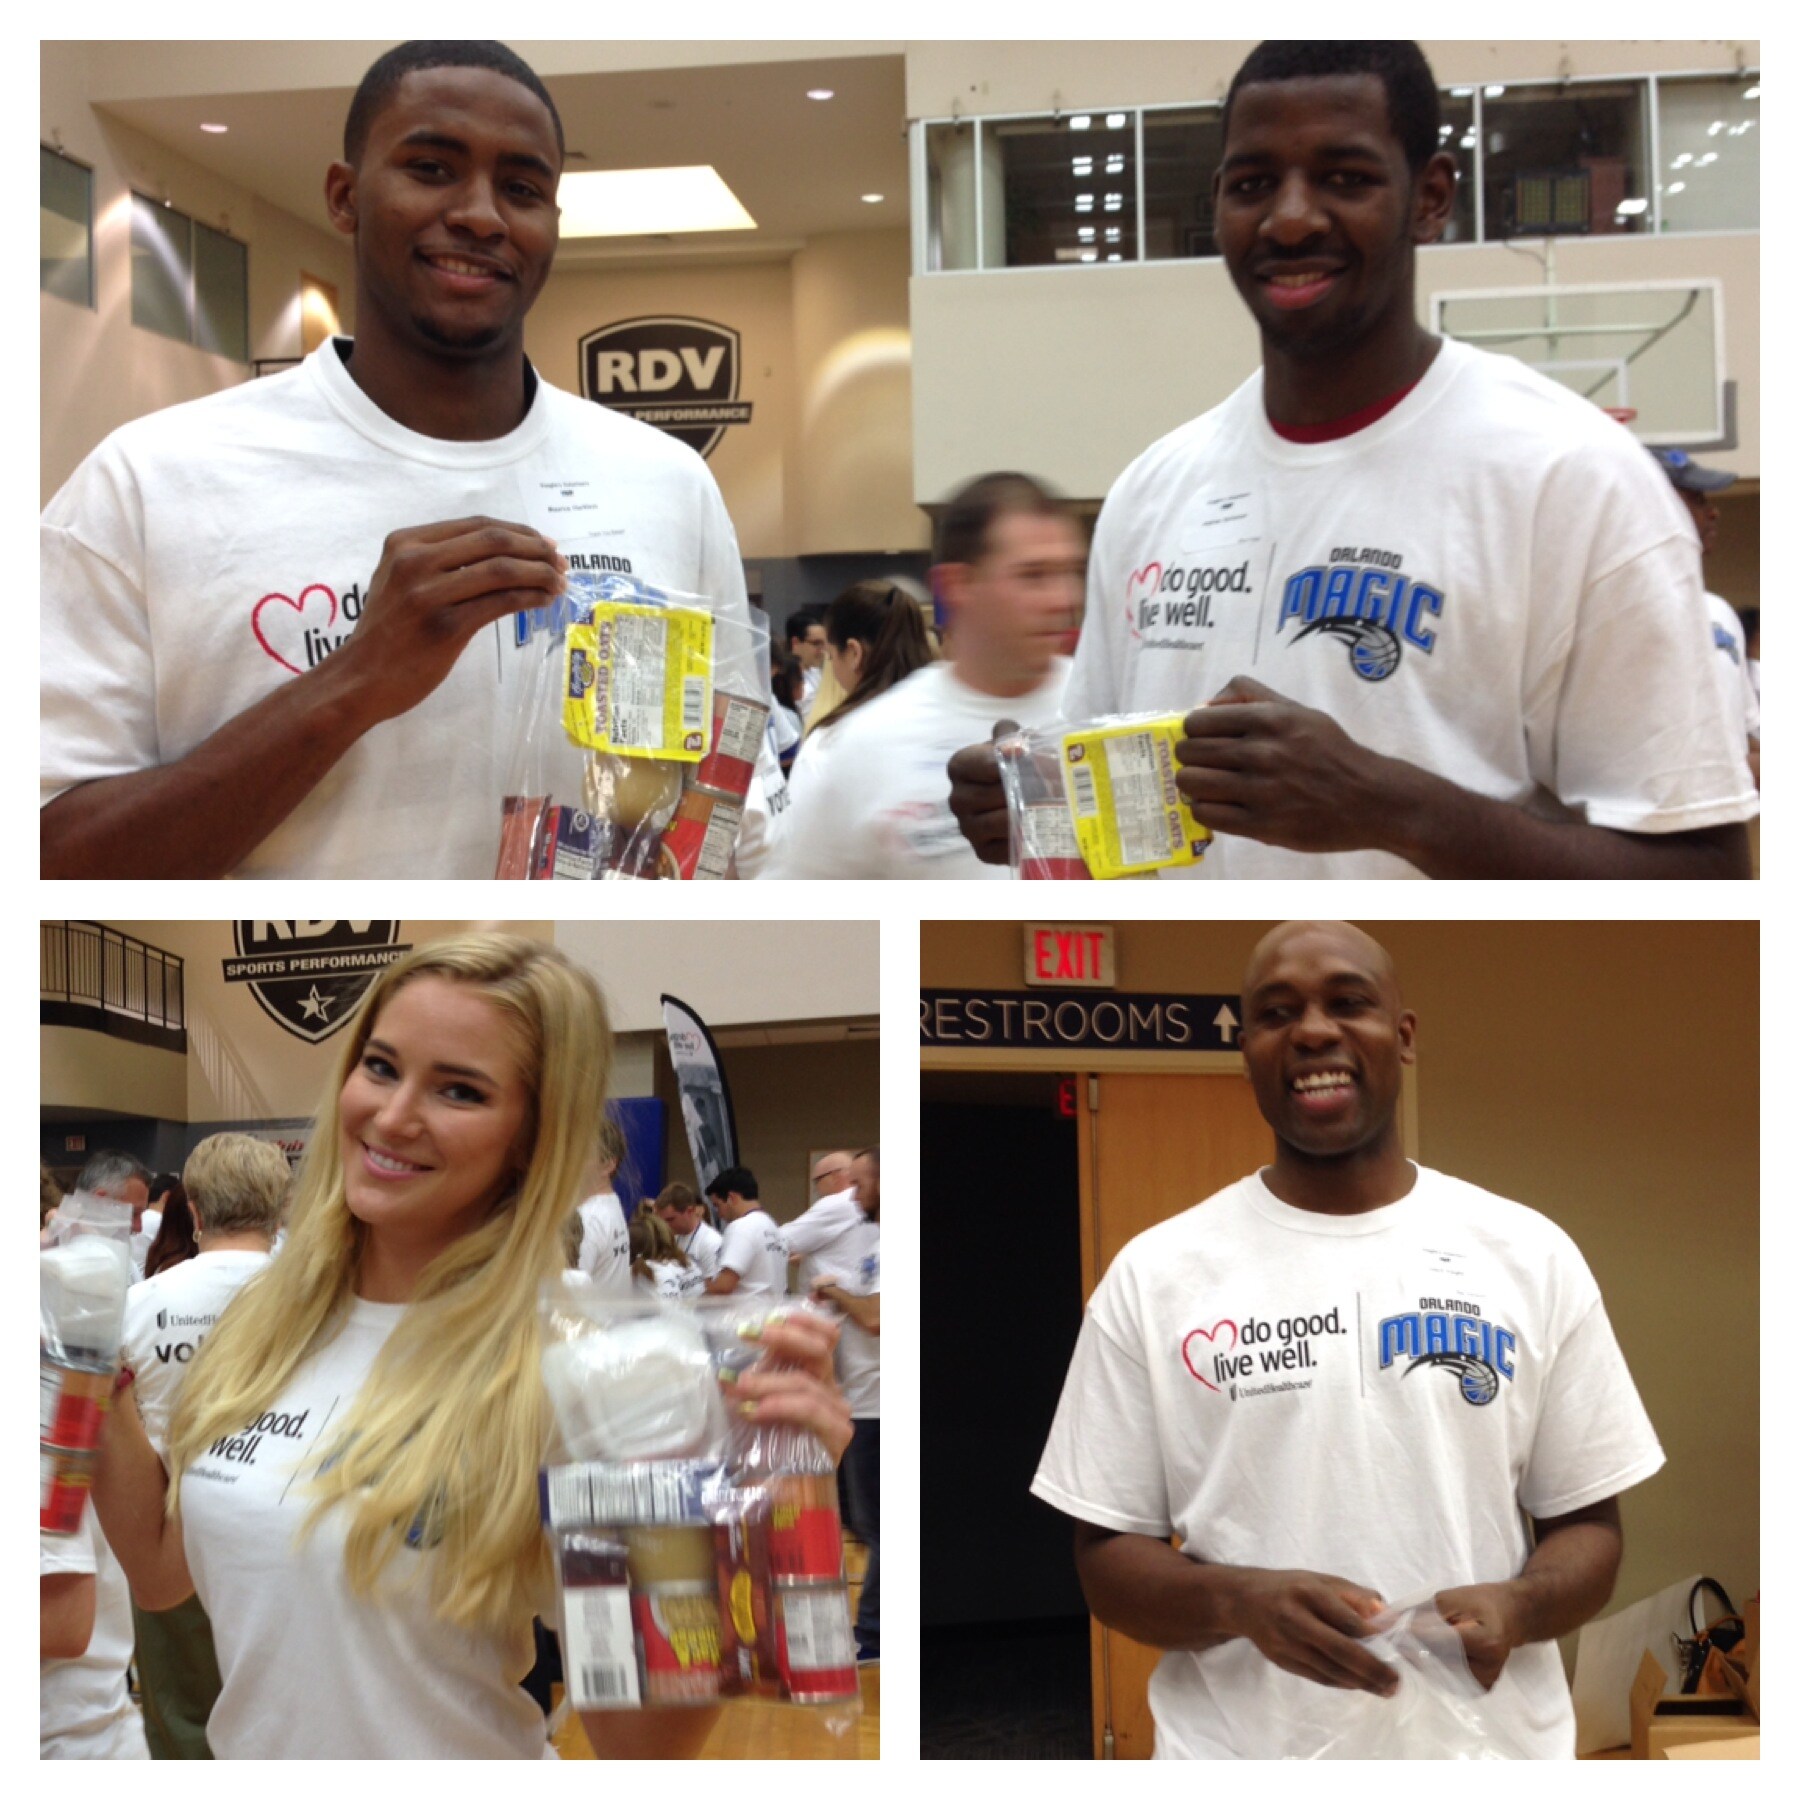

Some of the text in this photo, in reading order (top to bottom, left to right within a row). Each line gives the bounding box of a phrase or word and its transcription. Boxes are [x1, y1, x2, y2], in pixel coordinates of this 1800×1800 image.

[597, 345, 726, 393] RDV
[634, 406, 750, 421] PERFORMANCE
[565, 554, 632, 573] RLANDO
[1330, 547, 1403, 569] ORLANDO
[1187, 560, 1252, 599] good.
[342, 583, 369, 621] d
[1166, 595, 1215, 628] well.
[1276, 566, 1446, 656] MAGIC
[304, 628, 352, 668] liv
[595, 620, 612, 734] TOASTED OATS
[1157, 739, 1185, 849] TOASTED OATS
[226, 960, 286, 977] SPORTS
[1034, 930, 1106, 980] EXIT
[1419, 1297, 1481, 1316] ORLANDO
[1241, 1307, 1347, 1346] do good.
[1214, 1340, 1317, 1383] live well.
[1378, 1312, 1515, 1382] MAGIC
[208, 1434, 262, 1466] well.
